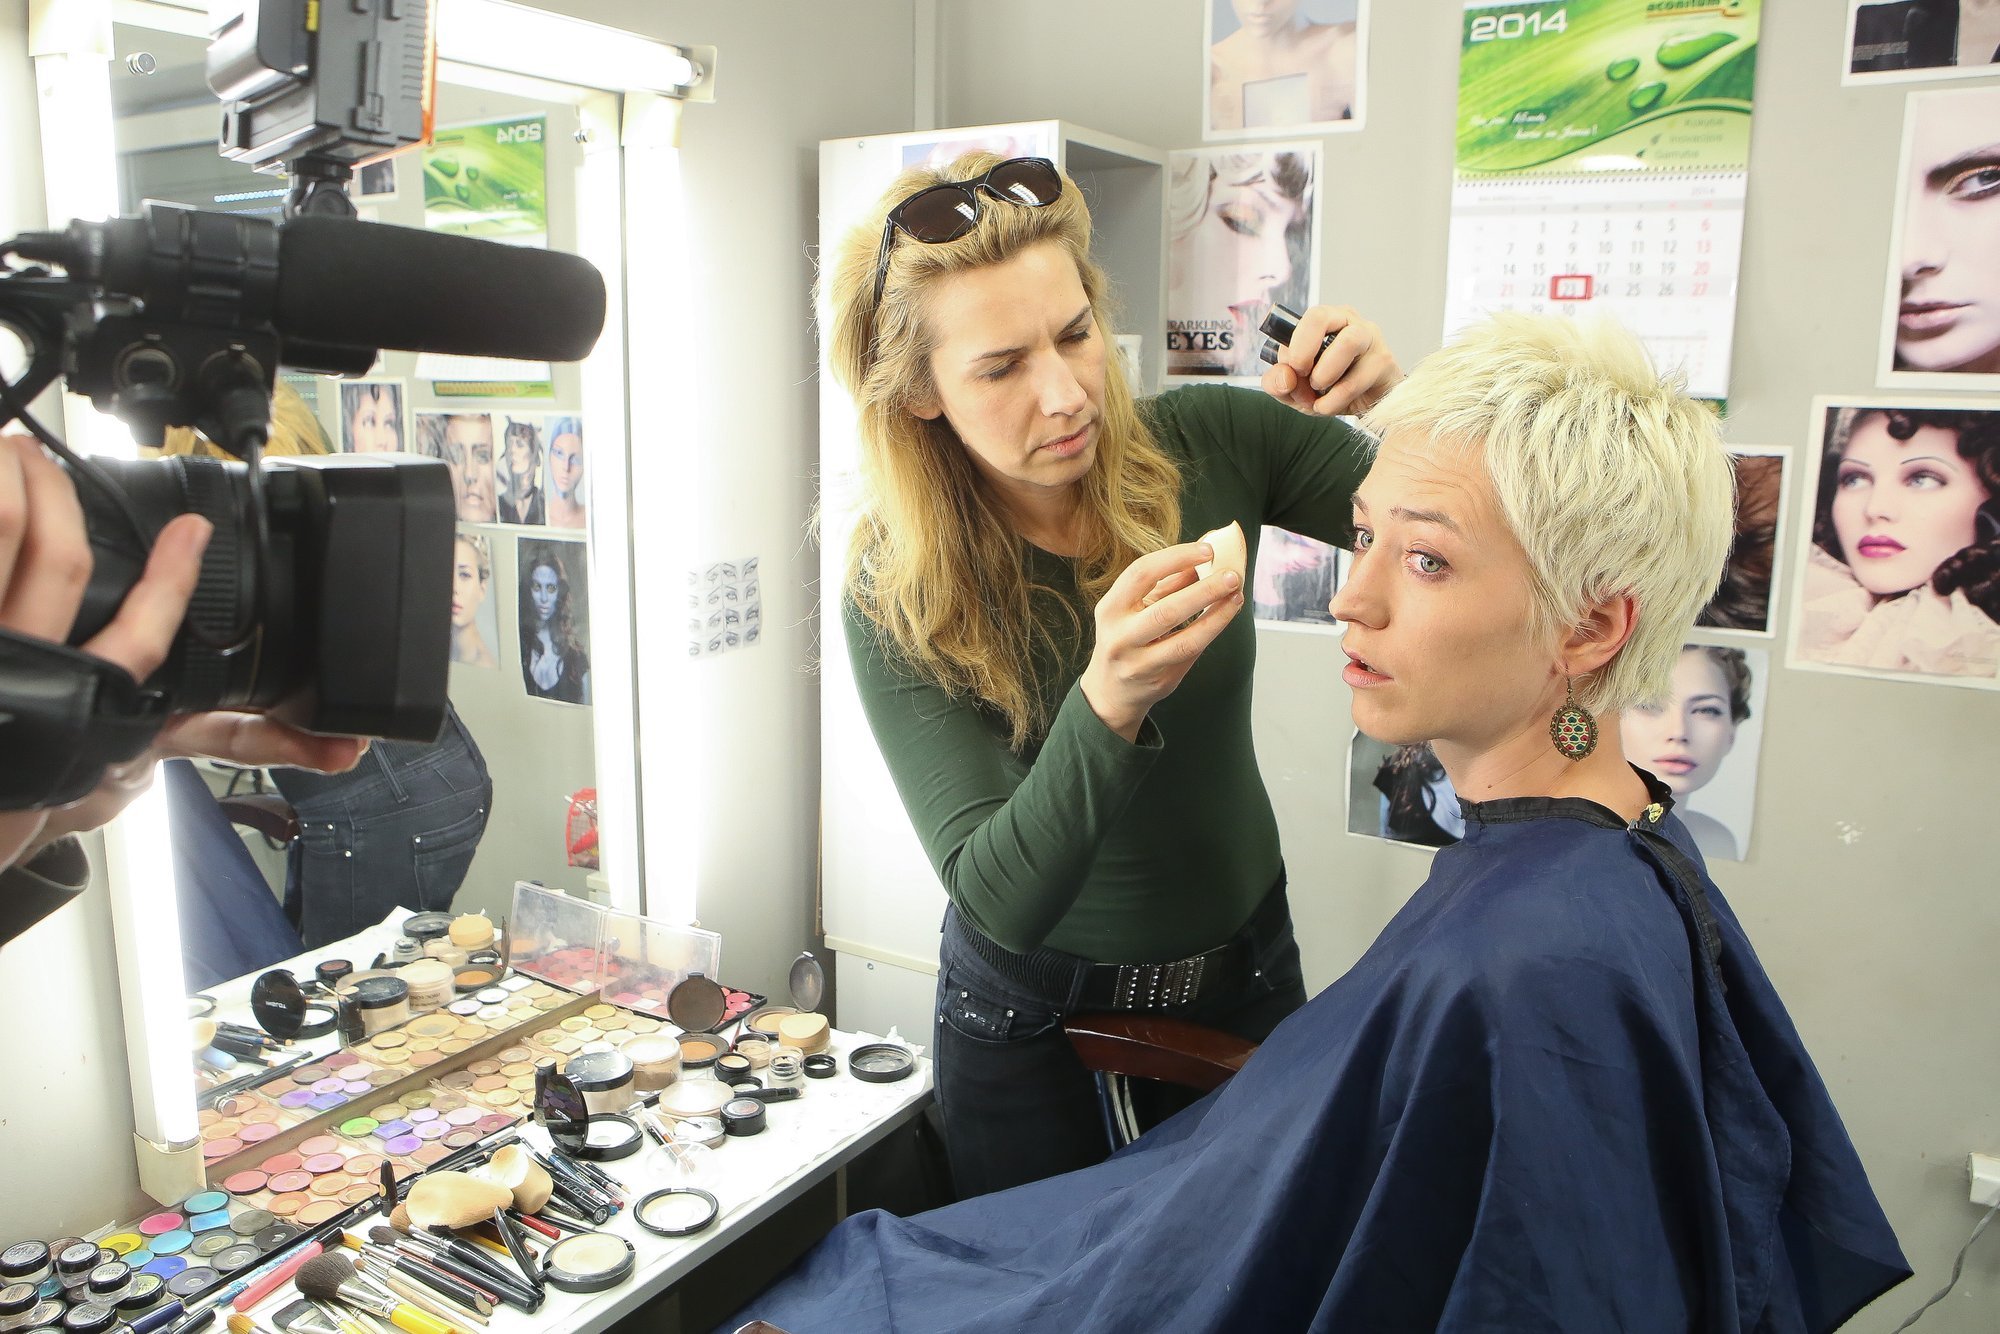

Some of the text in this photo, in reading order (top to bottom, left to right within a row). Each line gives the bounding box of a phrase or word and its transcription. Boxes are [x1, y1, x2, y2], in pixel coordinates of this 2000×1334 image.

[1469, 7, 1569, 42] 2014
[1571, 220, 1579, 234] 2
[1602, 220, 1611, 233] 3
[1634, 219, 1643, 232] 4
[1668, 217, 1677, 232] 5
[1701, 217, 1711, 232] 6
[1507, 240, 1712, 255] 7 8 9 10 11 12 13
[1503, 261, 1711, 276] 14 15 16 17 18 19 20
[1500, 282, 1709, 297] 21 22 23 24 25 26 27
[1167, 331, 1234, 351] EYES
